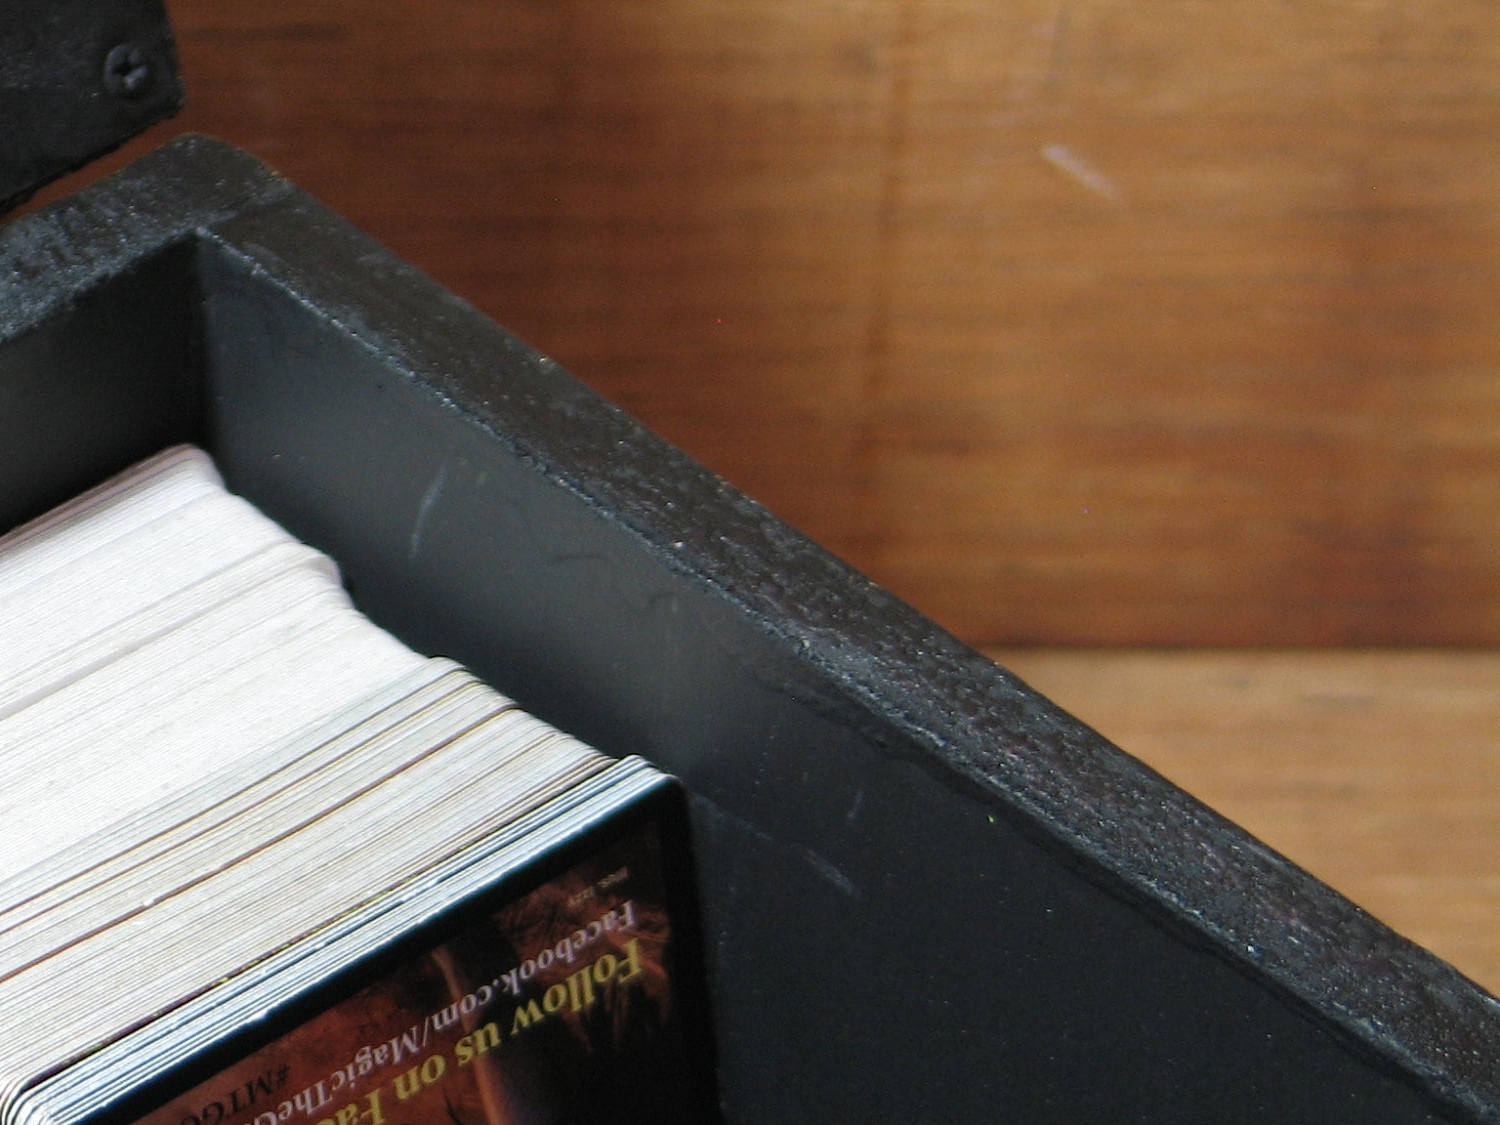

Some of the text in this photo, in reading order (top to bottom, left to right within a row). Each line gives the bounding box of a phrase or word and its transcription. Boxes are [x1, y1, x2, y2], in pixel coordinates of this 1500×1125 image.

[510, 936, 643, 1035] Follow
[453, 1021, 501, 1067] us
[391, 1053, 446, 1101] on
